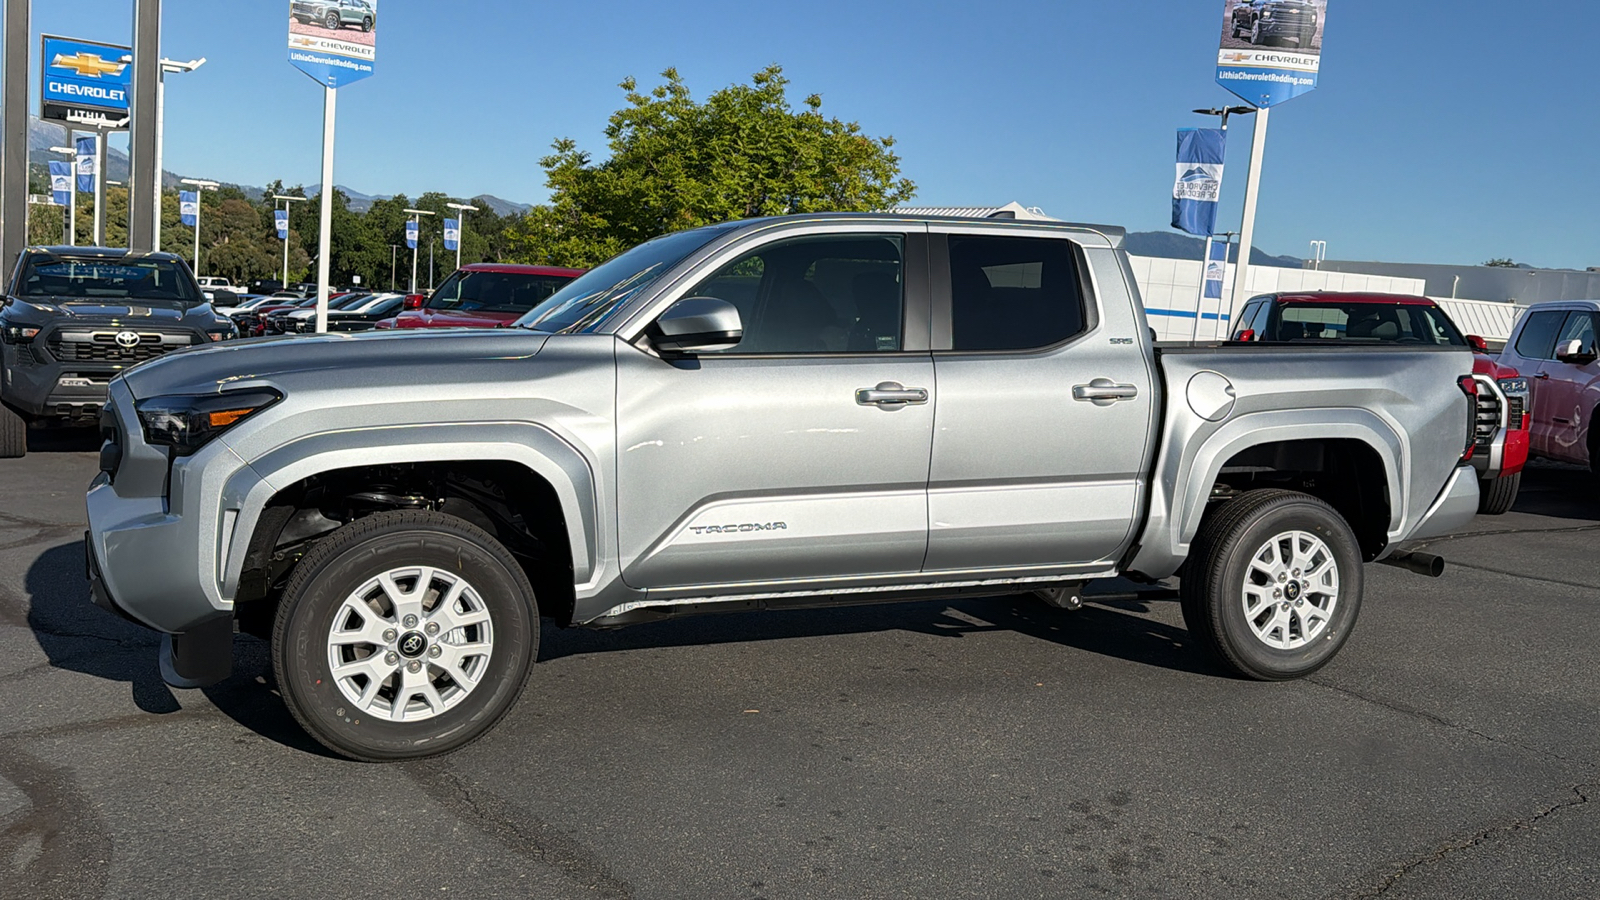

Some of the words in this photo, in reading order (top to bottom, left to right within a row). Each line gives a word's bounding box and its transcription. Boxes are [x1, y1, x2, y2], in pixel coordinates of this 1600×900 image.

[320, 41, 372, 55] CHEVROLET
[291, 52, 372, 72] LithiaChevroletRedding.com
[1254, 54, 1316, 66] CHEVROLET
[1219, 71, 1314, 86] LithiaChevroletRedding.com
[49, 81, 125, 101] CHEVROLET
[67, 109, 107, 120] LITHIA
[689, 521, 788, 535] TACOMA
